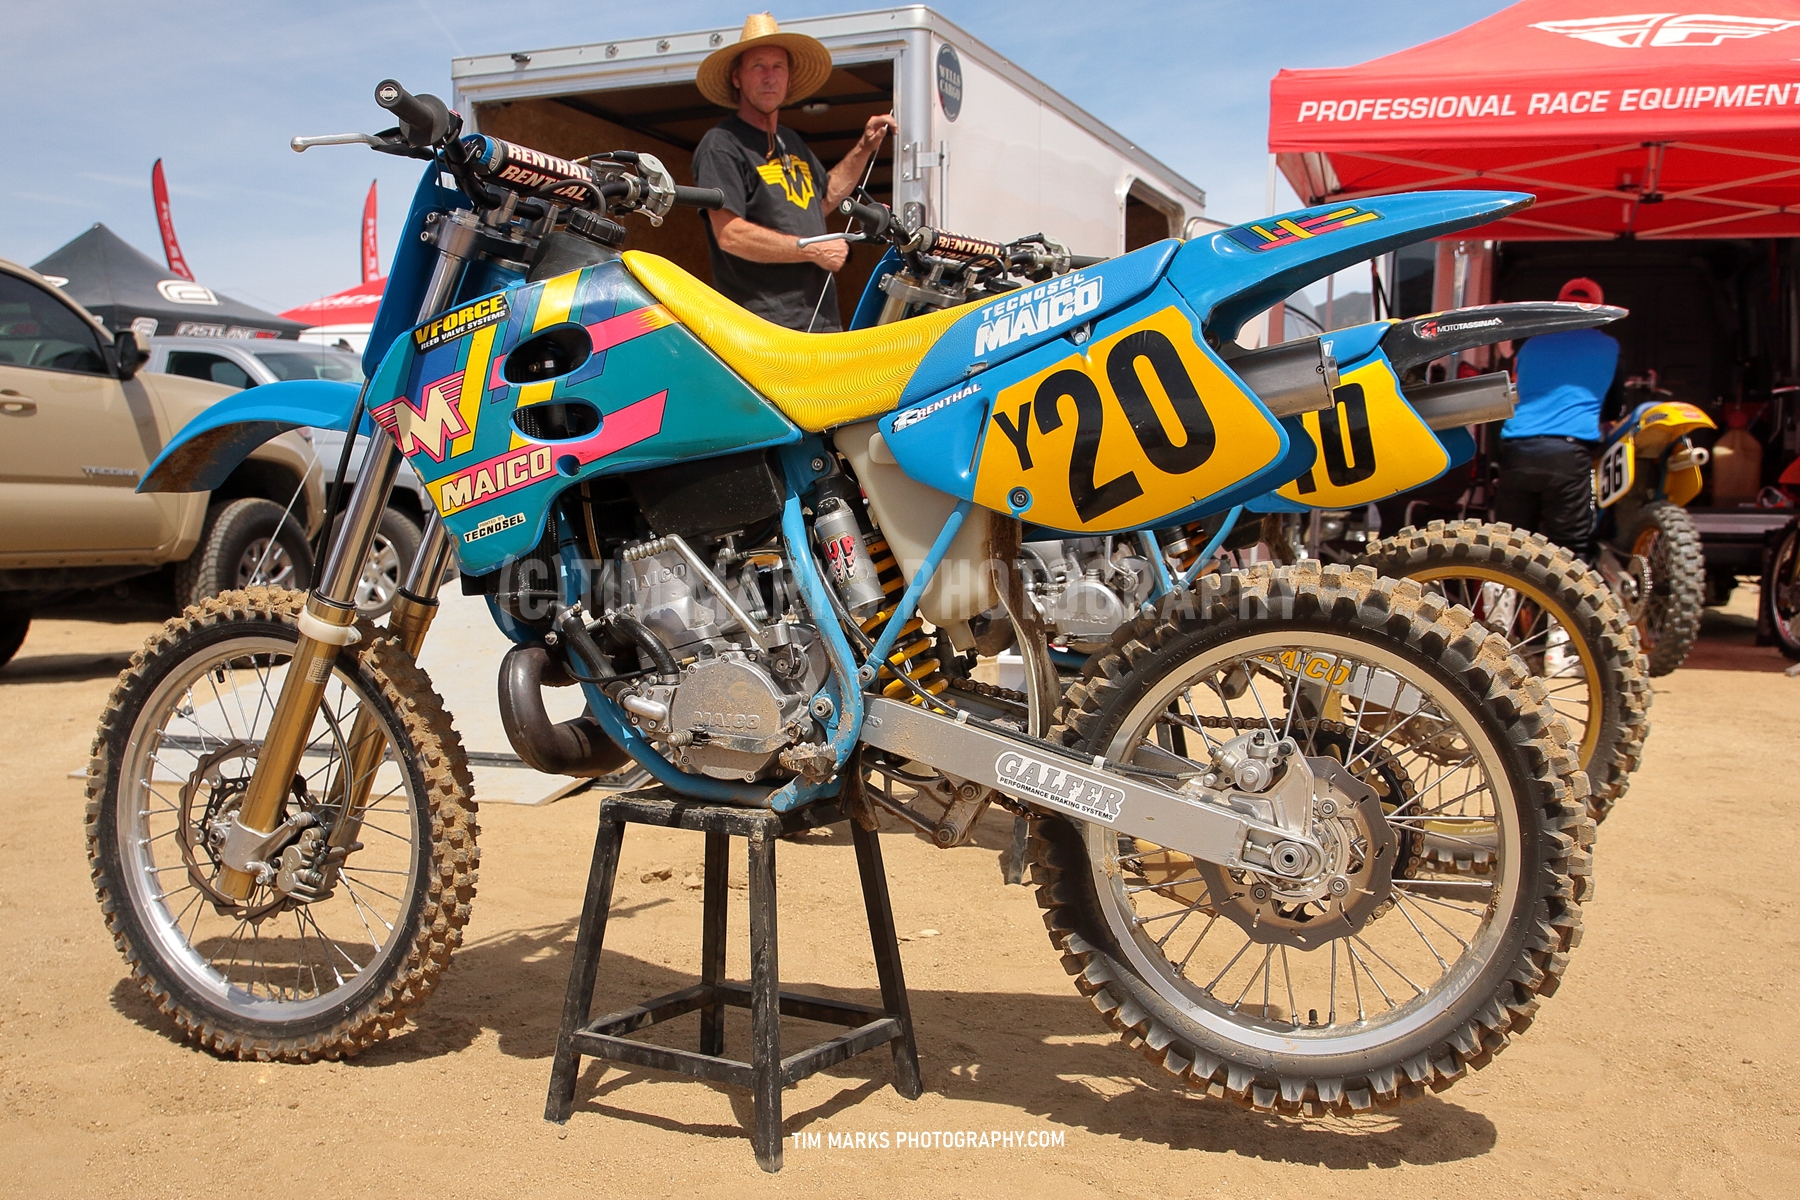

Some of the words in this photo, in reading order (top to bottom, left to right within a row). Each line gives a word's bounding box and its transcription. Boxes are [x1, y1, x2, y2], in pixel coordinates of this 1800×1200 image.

[1298, 95, 1516, 122] PROFESSIONAL
[1528, 90, 1610, 115] RACE
[507, 143, 593, 182] RENTHAL
[937, 236, 1002, 259] RENTHAL
[974, 276, 1103, 357] MAICO
[982, 274, 1085, 321] TECNOSEL
[415, 295, 504, 345] VFORCE
[420, 338, 440, 351] REED
[442, 325, 466, 341] VALVE
[467, 310, 506, 330] SYSTEMS
[917, 383, 982, 419] RENTHAL
[441, 446, 552, 512] MAICO
[464, 515, 524, 541] TECNOSEL
[693, 711, 760, 729] MAICO
[998, 753, 1124, 815] GALFER
[1000, 776, 1048, 798] PERFORMANCE
[1050, 794, 1080, 809] BRAKING
[1081, 805, 1113, 820] SYSTEMS
